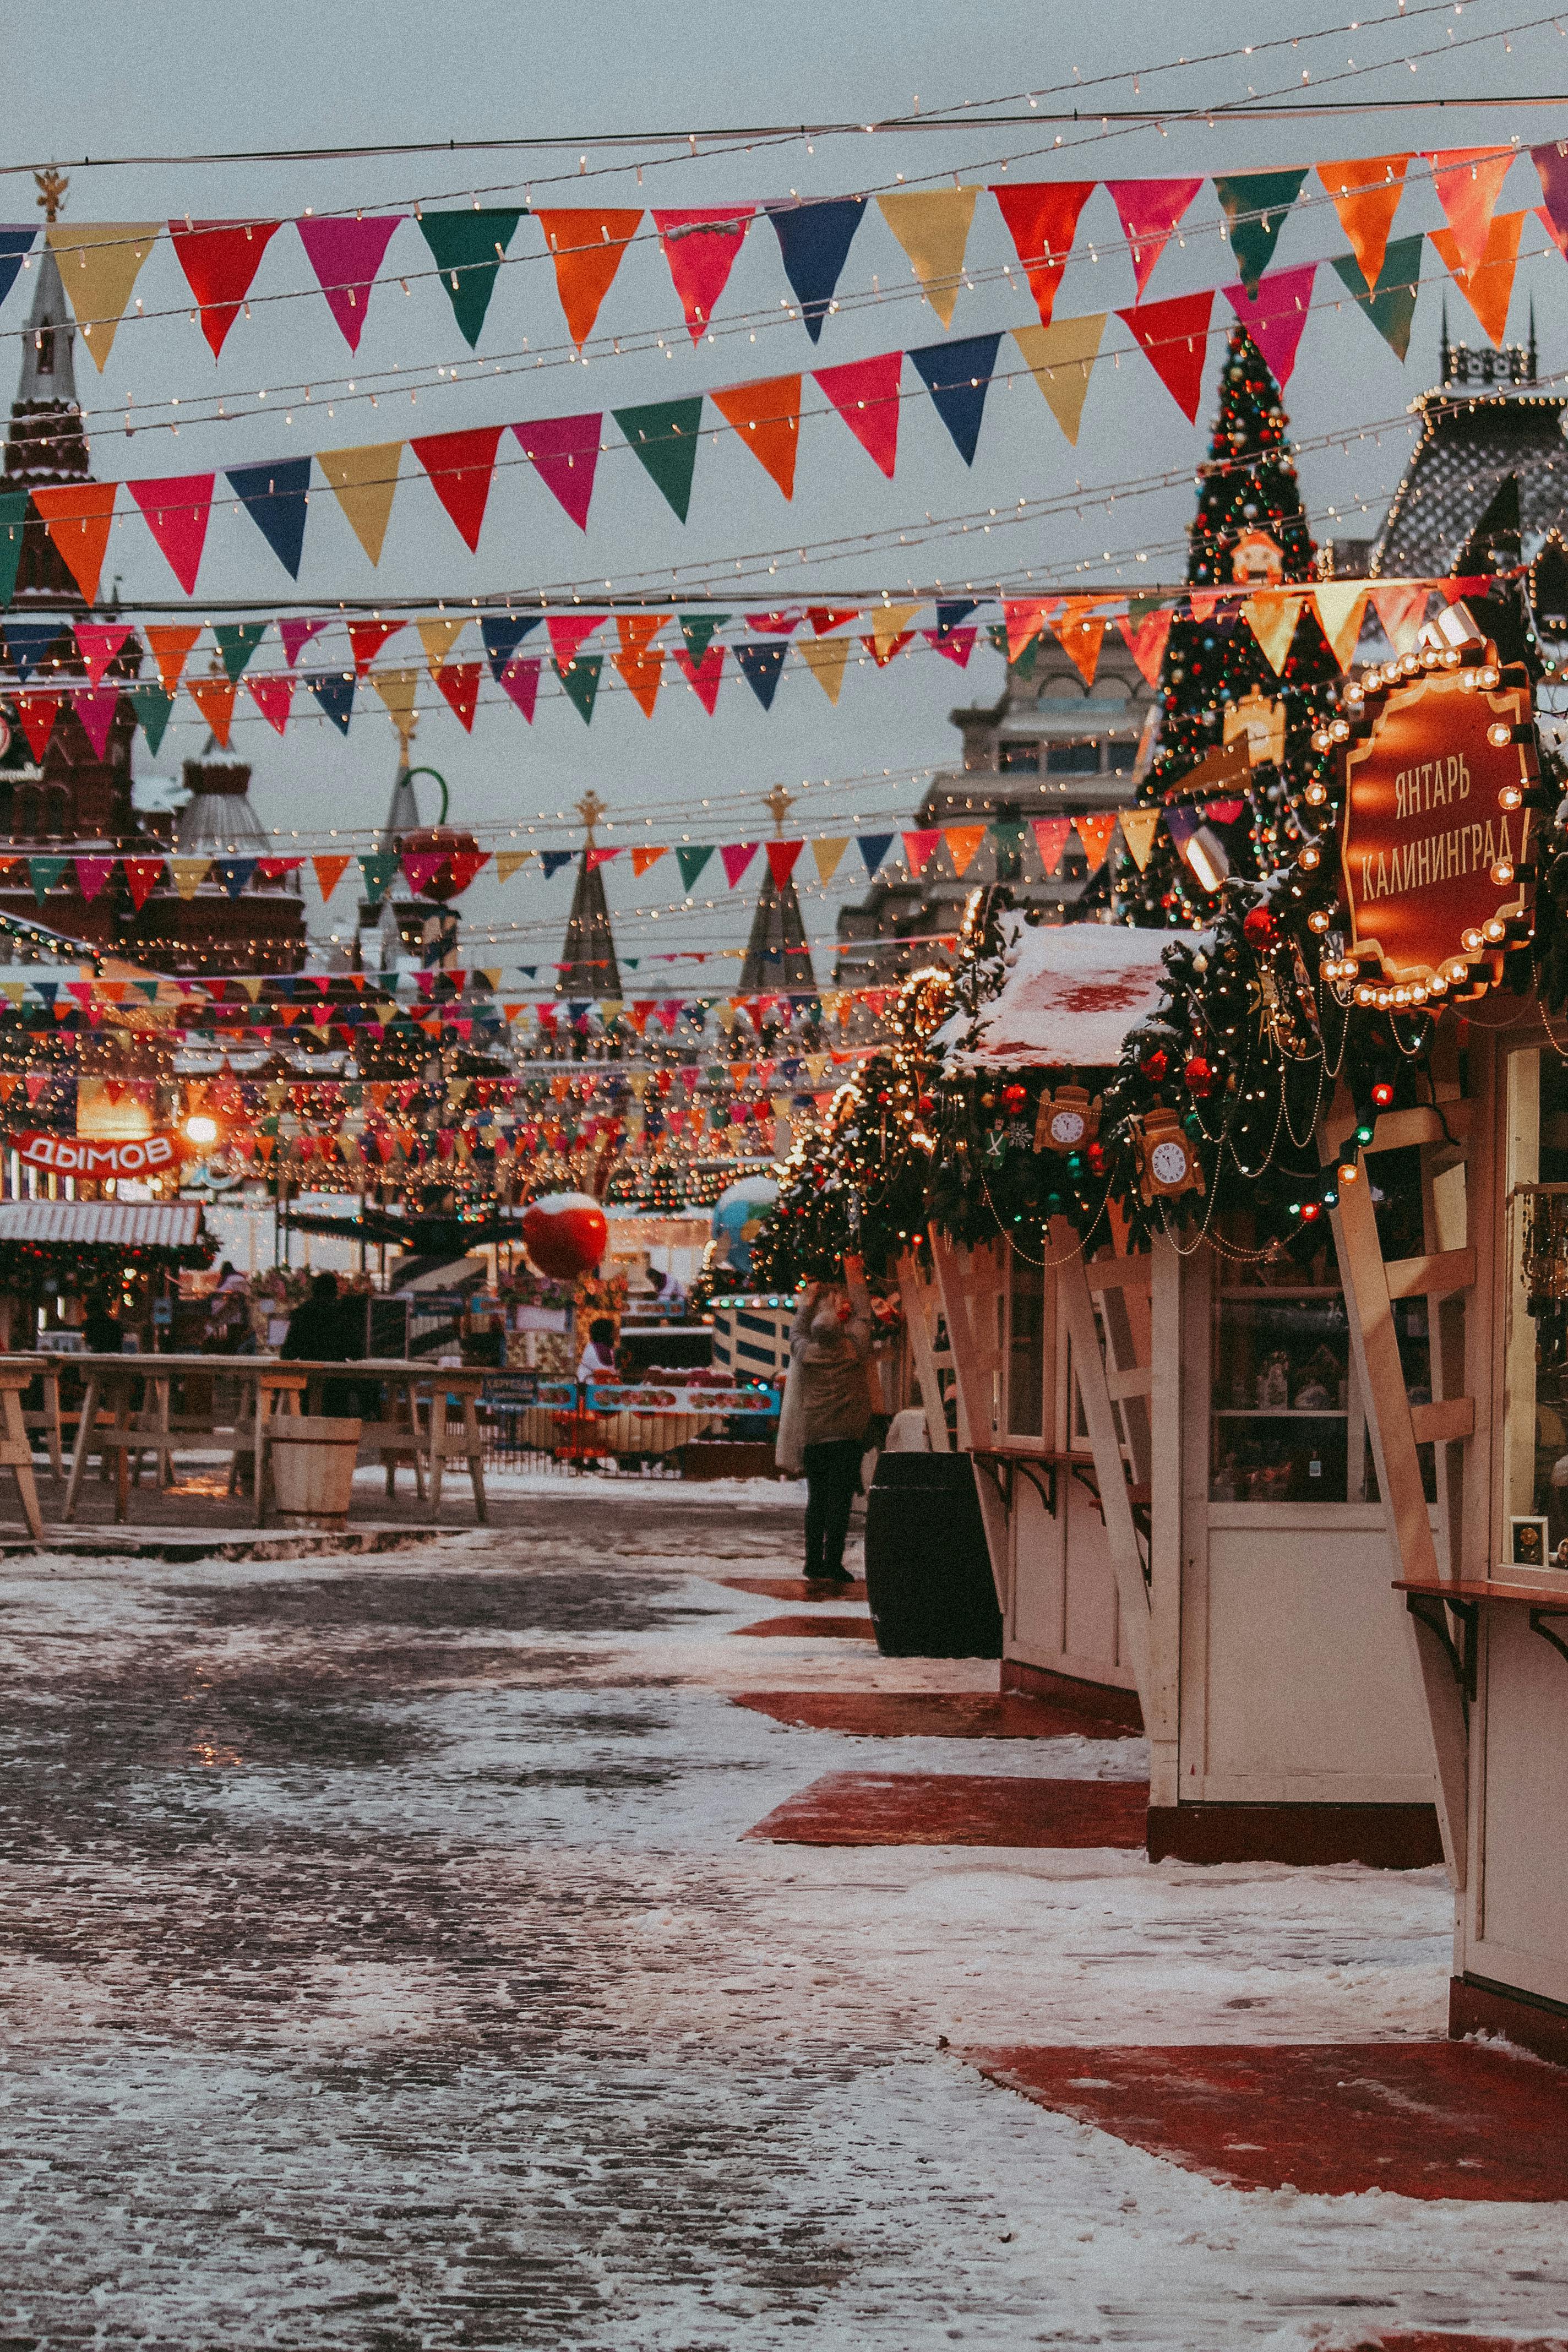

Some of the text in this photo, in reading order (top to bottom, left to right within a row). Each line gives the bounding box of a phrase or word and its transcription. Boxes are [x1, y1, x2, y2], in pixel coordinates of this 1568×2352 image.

[1395, 752, 1471, 819] ЯНТАРЬ
[1362, 815, 1513, 902] КАЛИНИНГРАД
[21, 1137, 172, 1171] ДЫМОВ
